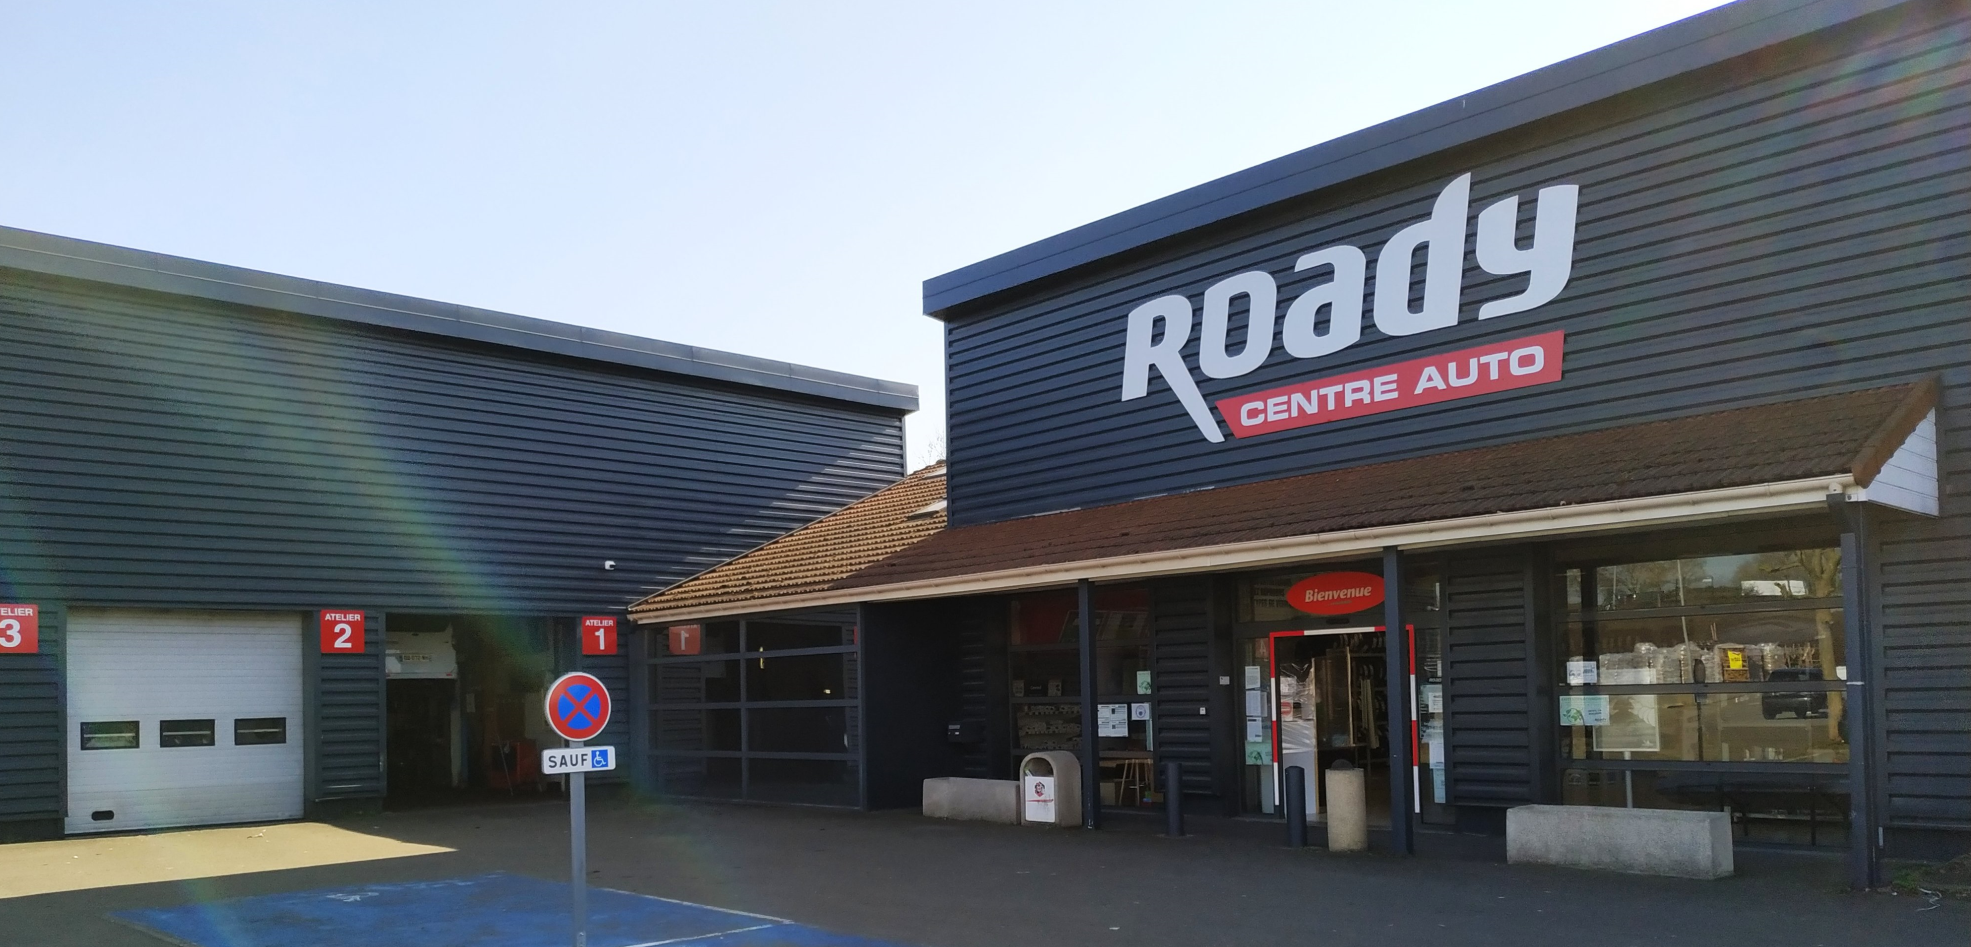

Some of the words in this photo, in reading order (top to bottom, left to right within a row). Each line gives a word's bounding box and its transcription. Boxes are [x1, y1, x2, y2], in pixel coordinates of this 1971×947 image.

[1240, 373, 1399, 427] CENTRE
[1414, 345, 1545, 395] AUTO
[1305, 586, 1372, 603] Bienvenue
[0, 608, 33, 616] ELIER
[0, 619, 21, 648] 3
[334, 623, 352, 648] 2
[594, 628, 605, 650] 1
[548, 753, 588, 768] SAUF
